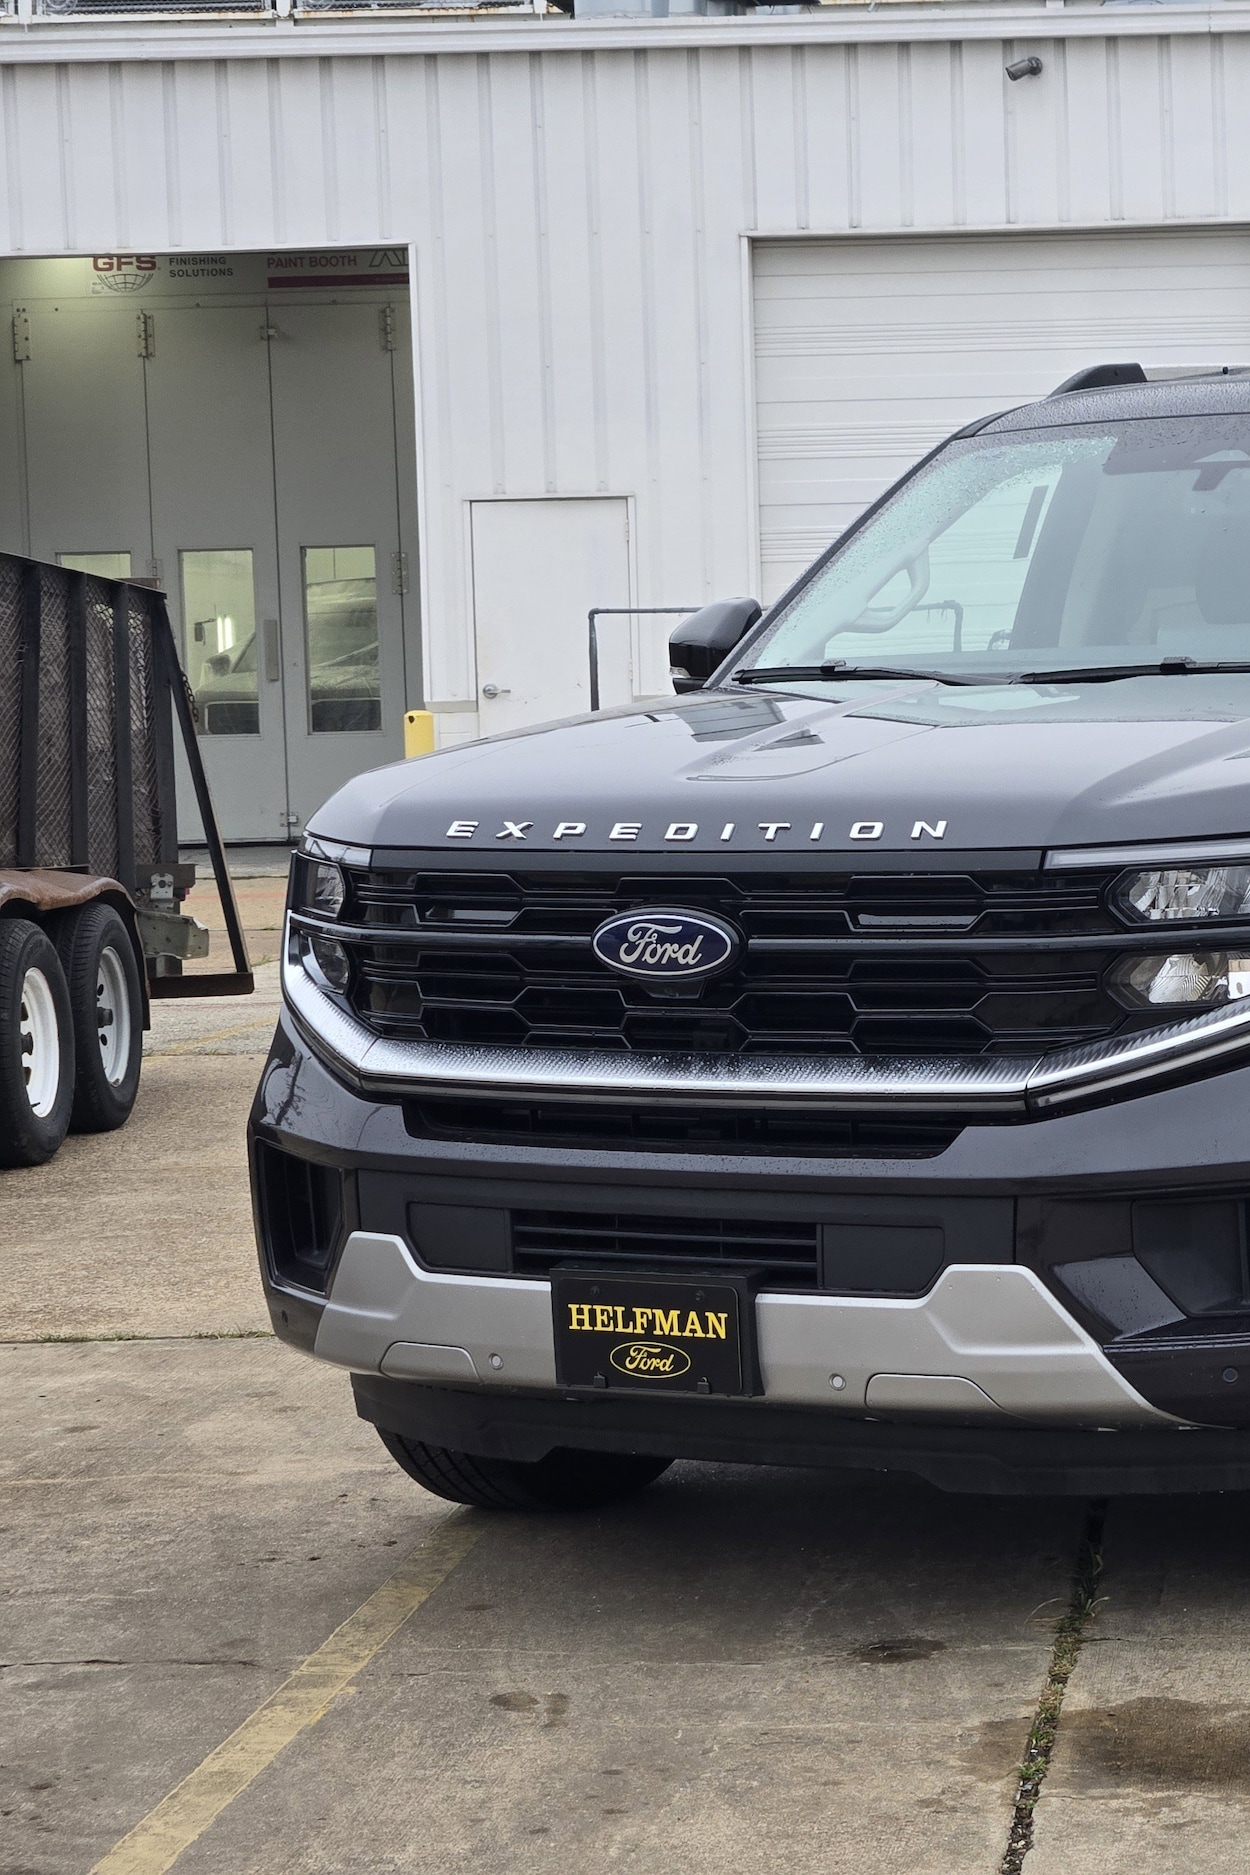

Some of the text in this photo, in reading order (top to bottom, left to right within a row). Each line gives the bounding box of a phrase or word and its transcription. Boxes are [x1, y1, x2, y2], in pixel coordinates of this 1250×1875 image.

[93, 255, 157, 272] GFS
[169, 256, 227, 266] FINISHING
[267, 257, 305, 269] PAINT
[309, 255, 357, 268] BOOTH
[169, 268, 234, 278] SOLUTIONS
[446, 819, 948, 842] EXPEDITION
[619, 922, 704, 966] Ford
[567, 1303, 729, 1340] HELFMAN
[625, 1344, 675, 1372] Ford
